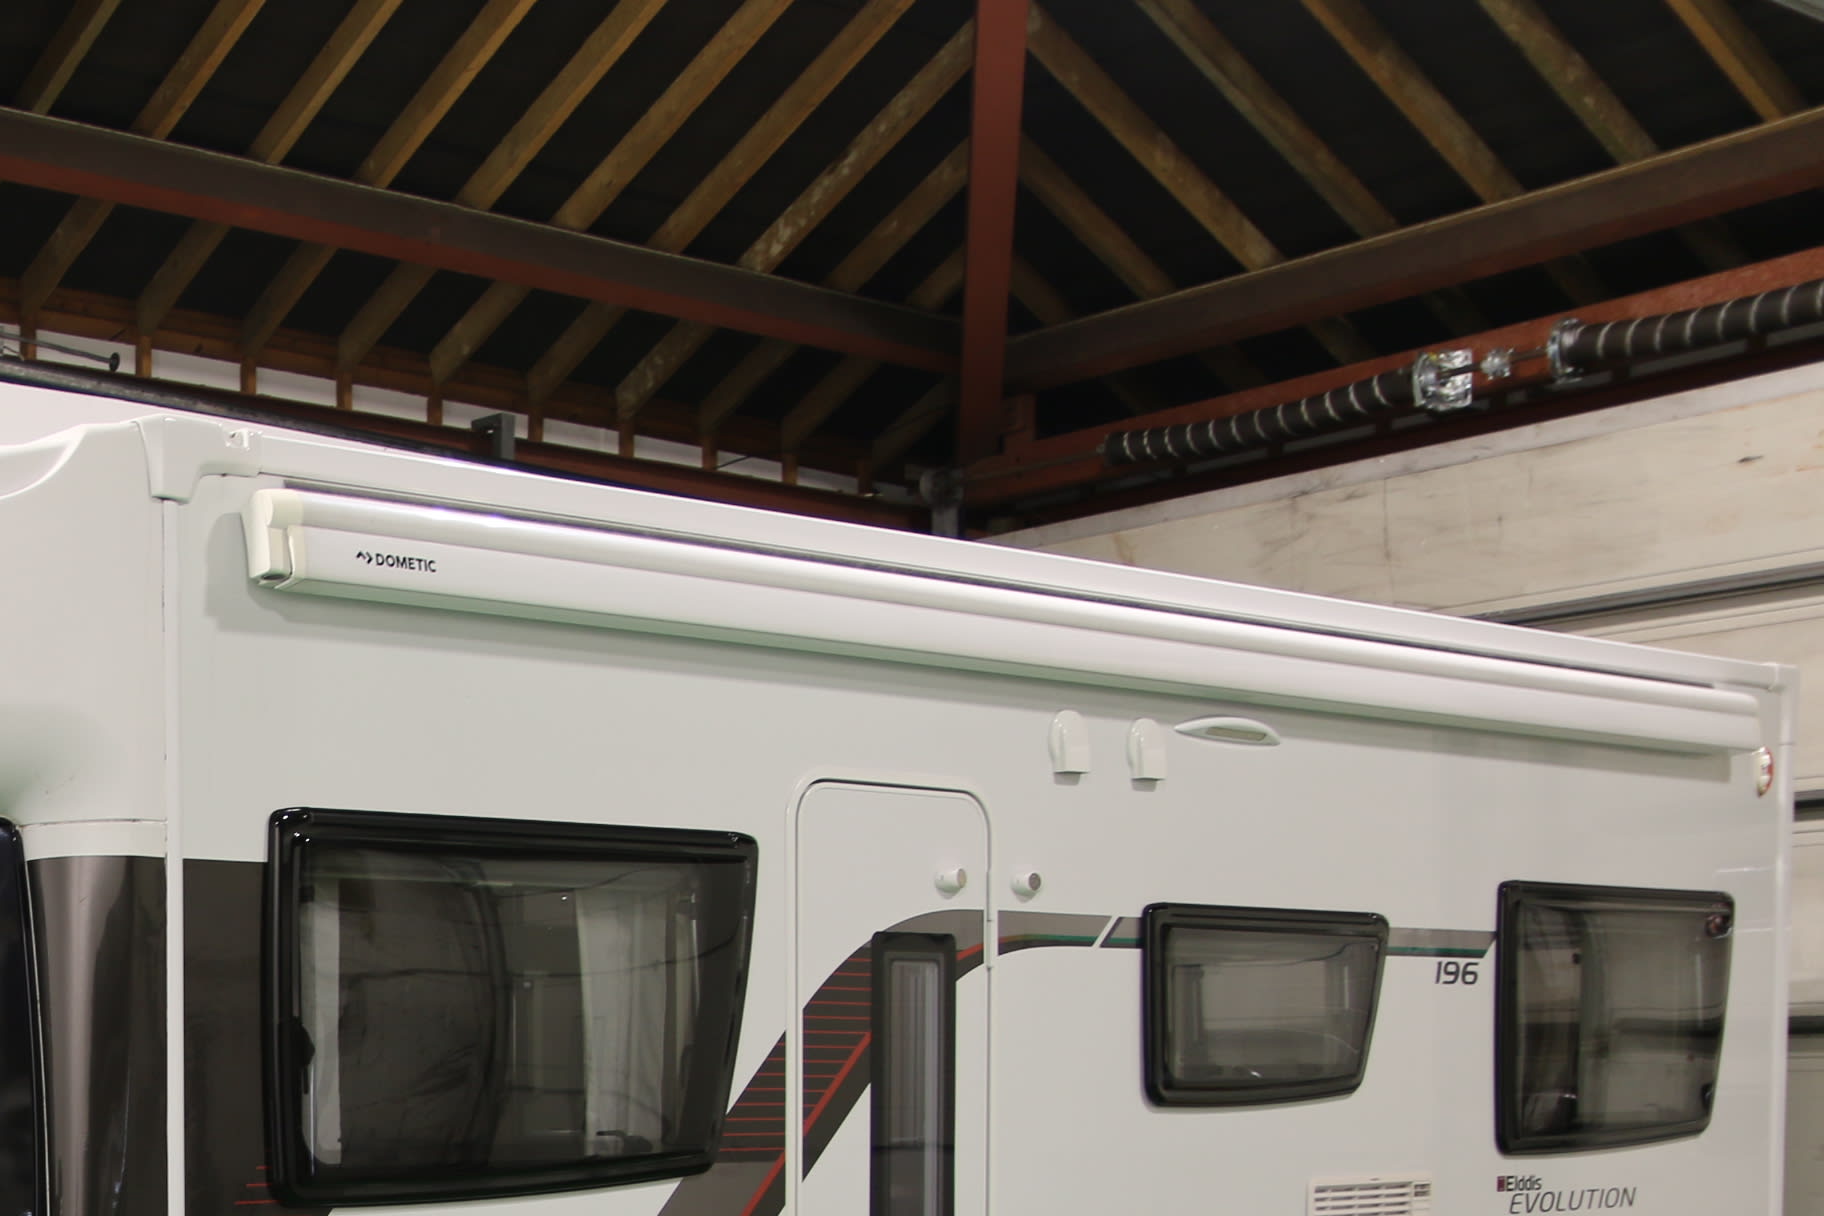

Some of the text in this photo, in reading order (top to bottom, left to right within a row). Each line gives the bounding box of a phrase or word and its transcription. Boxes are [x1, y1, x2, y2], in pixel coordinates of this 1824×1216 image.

[375, 552, 437, 573] DOMETIC
[1434, 960, 1480, 985] 196
[1505, 1174, 1542, 1192] Elddis
[1509, 1186, 1637, 1214] EVOLUTION
